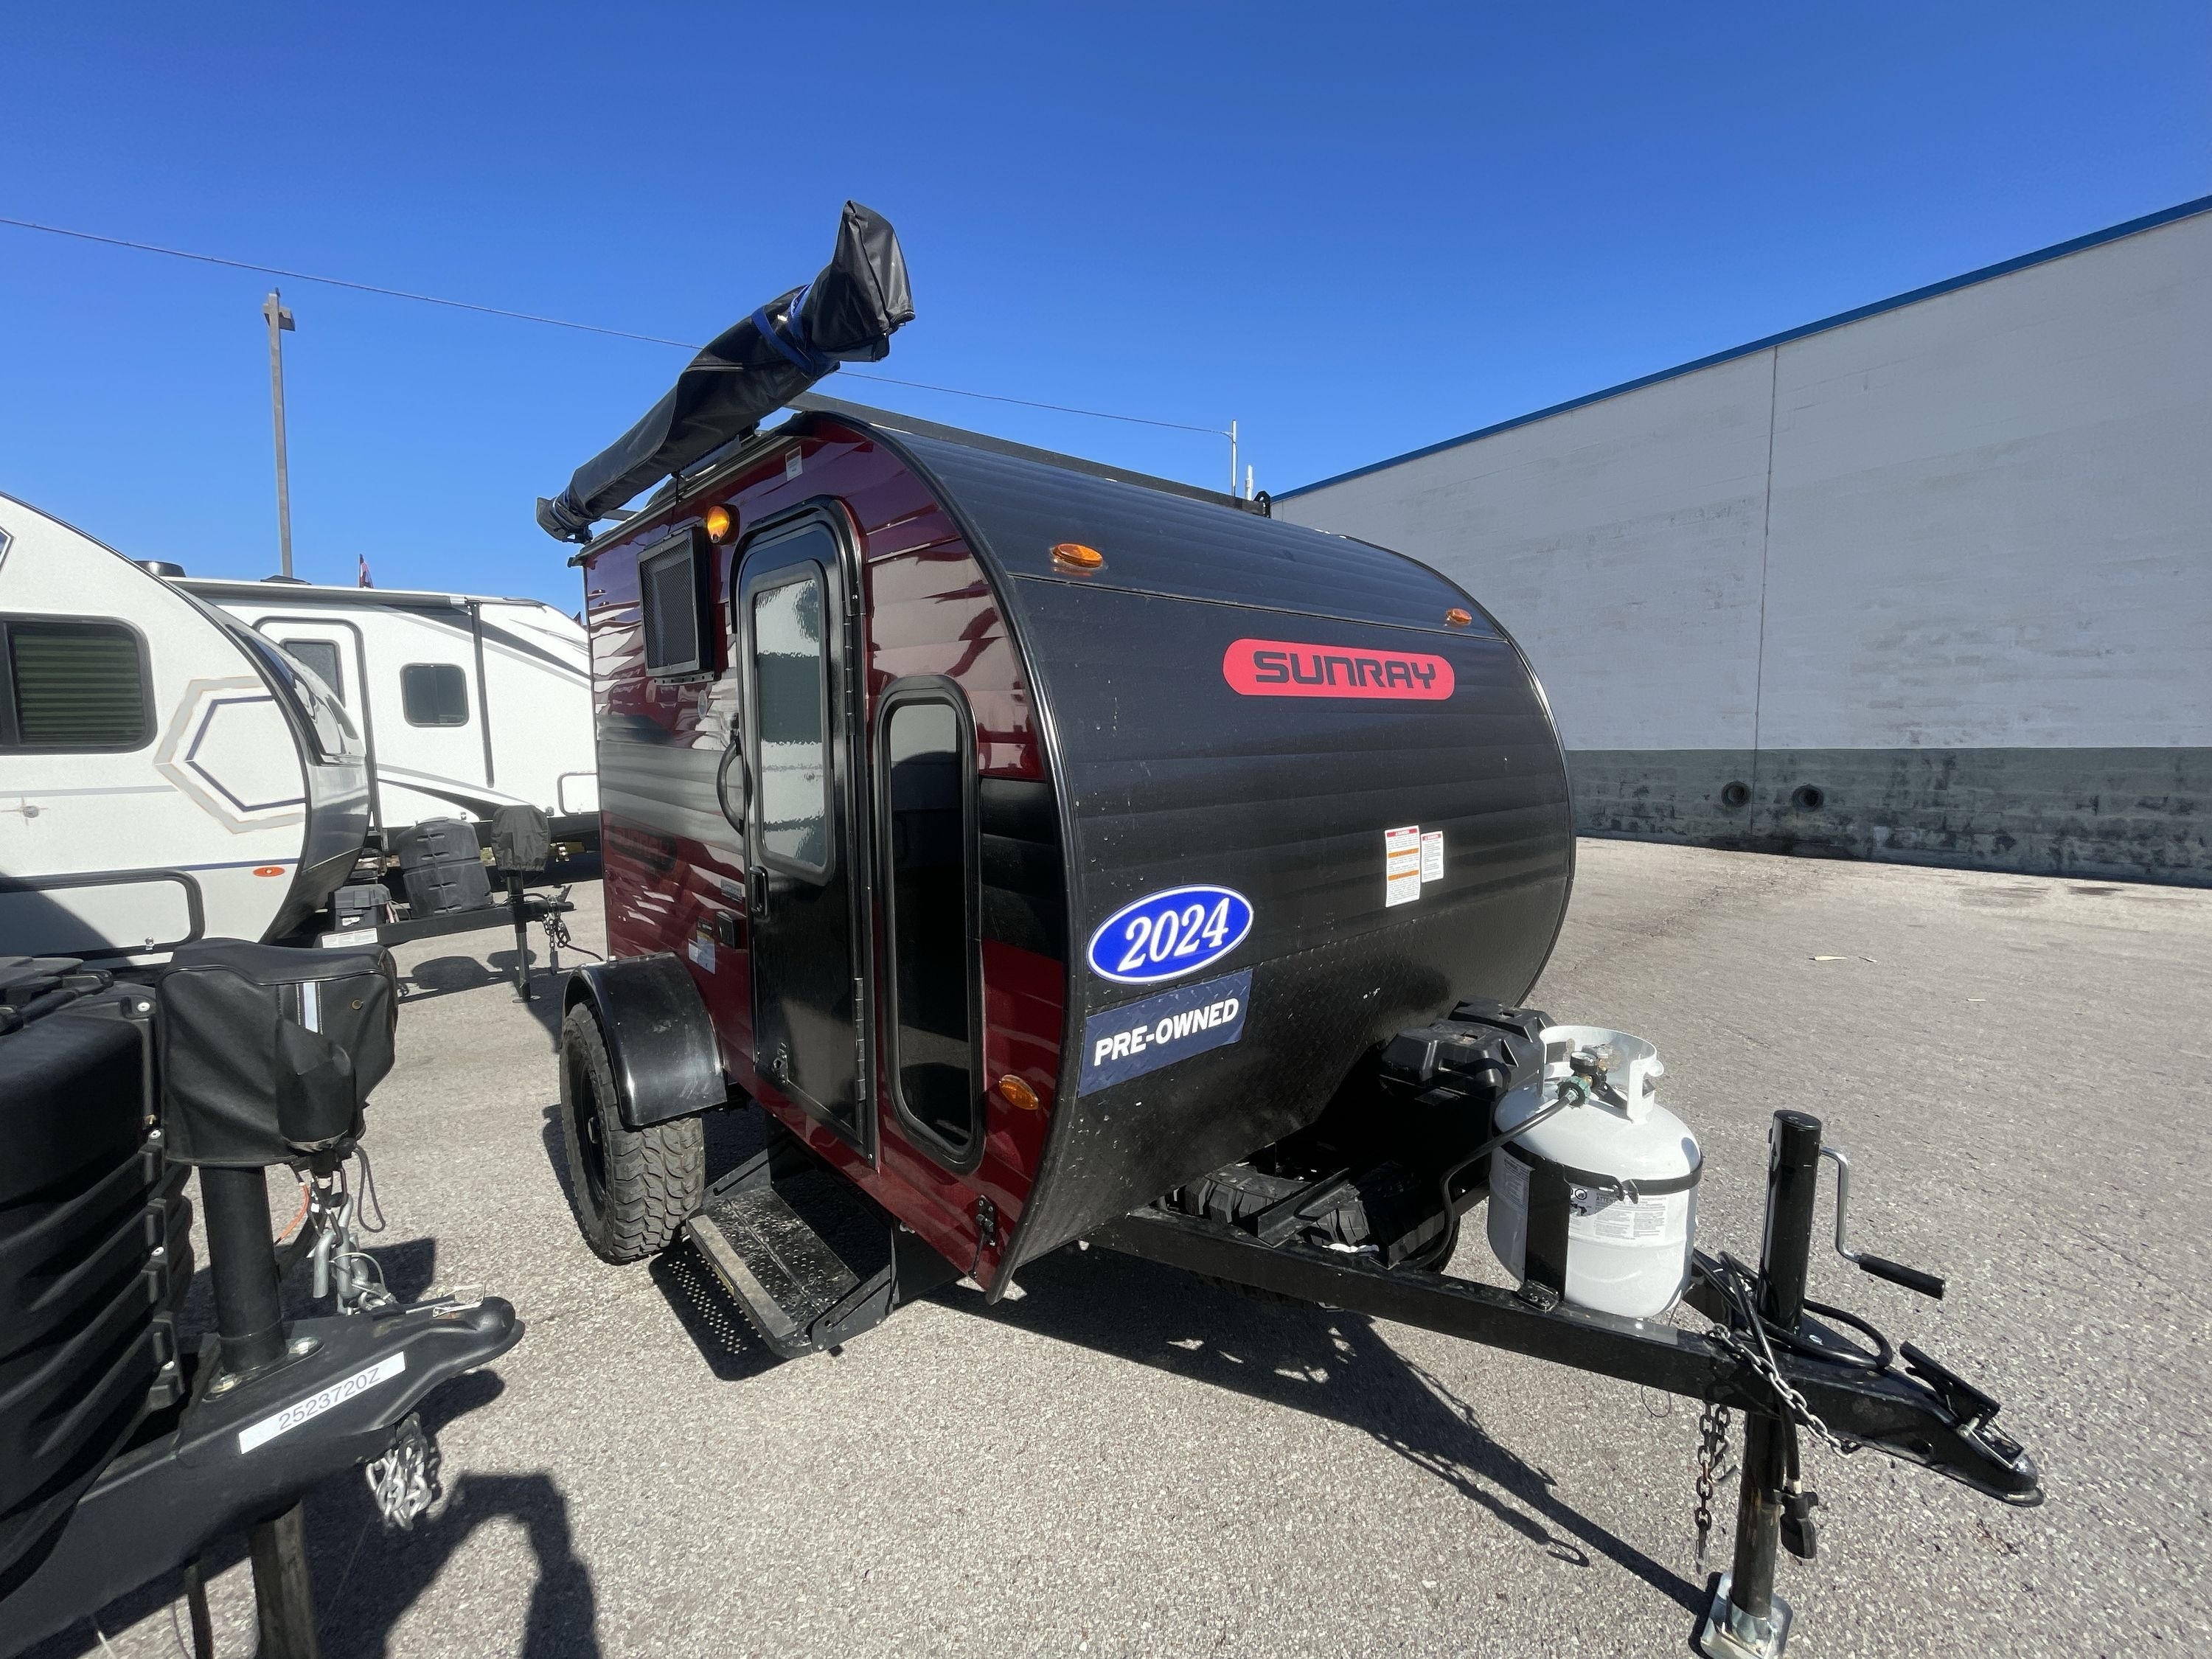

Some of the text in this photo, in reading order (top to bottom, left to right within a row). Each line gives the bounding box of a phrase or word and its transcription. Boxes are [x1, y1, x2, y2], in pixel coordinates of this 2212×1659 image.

[1253, 650, 1436, 689] SUNRAY
[1117, 897, 1230, 973] 2024
[1093, 998, 1239, 1066] PRE-OWNED
